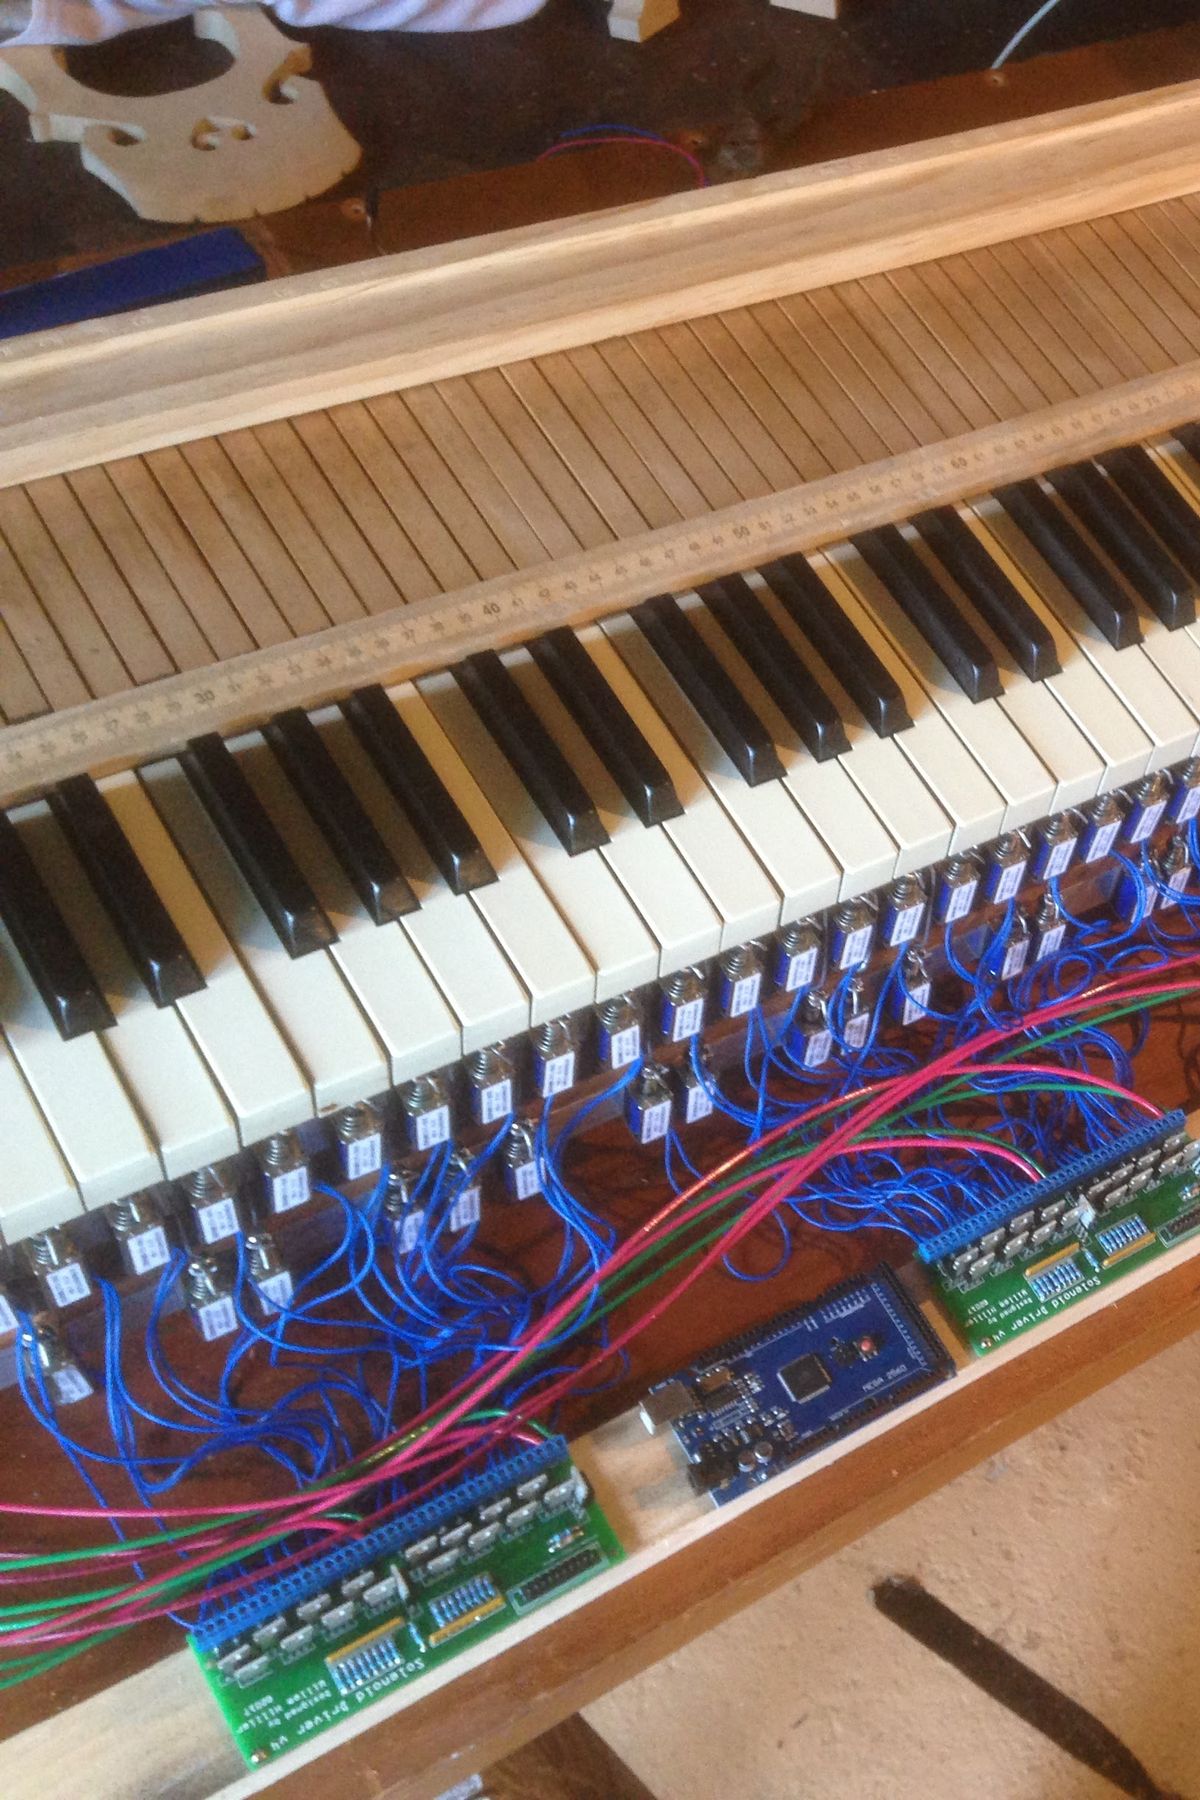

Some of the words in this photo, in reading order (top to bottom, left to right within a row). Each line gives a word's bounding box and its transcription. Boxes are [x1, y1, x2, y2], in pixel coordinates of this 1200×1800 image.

[483, 602, 500, 616] 40
[733, 525, 750, 539] 50
[1051, 1276, 1101, 1309] Solenoid
[1011, 1306, 1048, 1331] Driver
[992, 1330, 1006, 1342] v4
[355, 1657, 425, 1703] Solenoid
[297, 1700, 349, 1735] Driver
[270, 1735, 288, 1751] v4
